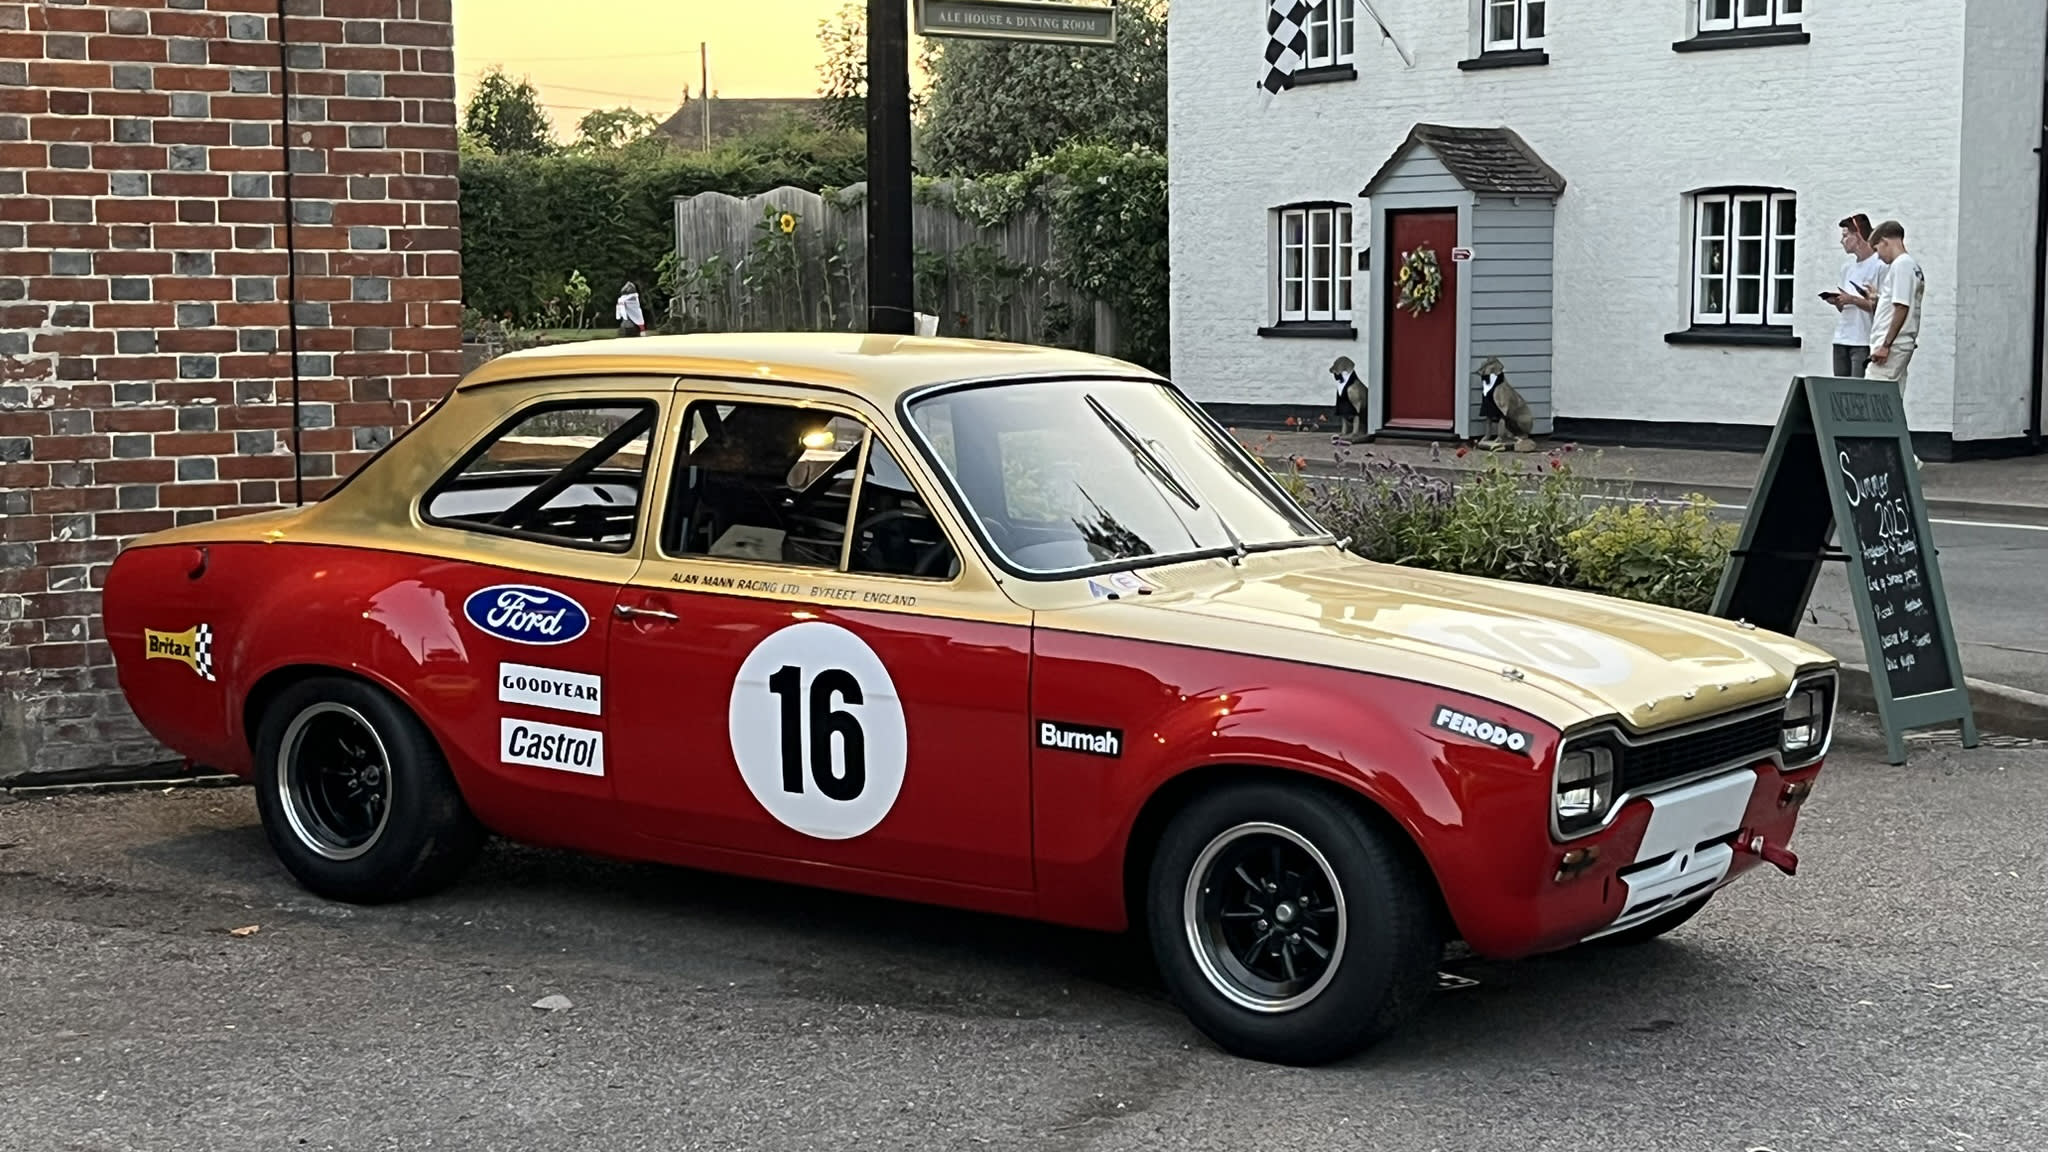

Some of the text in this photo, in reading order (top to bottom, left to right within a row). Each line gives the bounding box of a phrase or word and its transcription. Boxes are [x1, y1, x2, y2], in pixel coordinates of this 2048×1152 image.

[939, 12, 1095, 31] ALE HOUSE & DINING ROOM
[1839, 451, 1888, 507] Summer
[671, 572, 699, 584] ALAN
[701, 576, 734, 588] MANN
[737, 580, 777, 593] RACING
[487, 590, 567, 636] Ford
[149, 635, 191, 658] Britax
[503, 675, 598, 701] GOODYEAR
[508, 726, 597, 767] Castrol
[769, 665, 866, 801] 16
[1041, 722, 1119, 755] Burmah
[1436, 708, 1526, 751] FERODO
